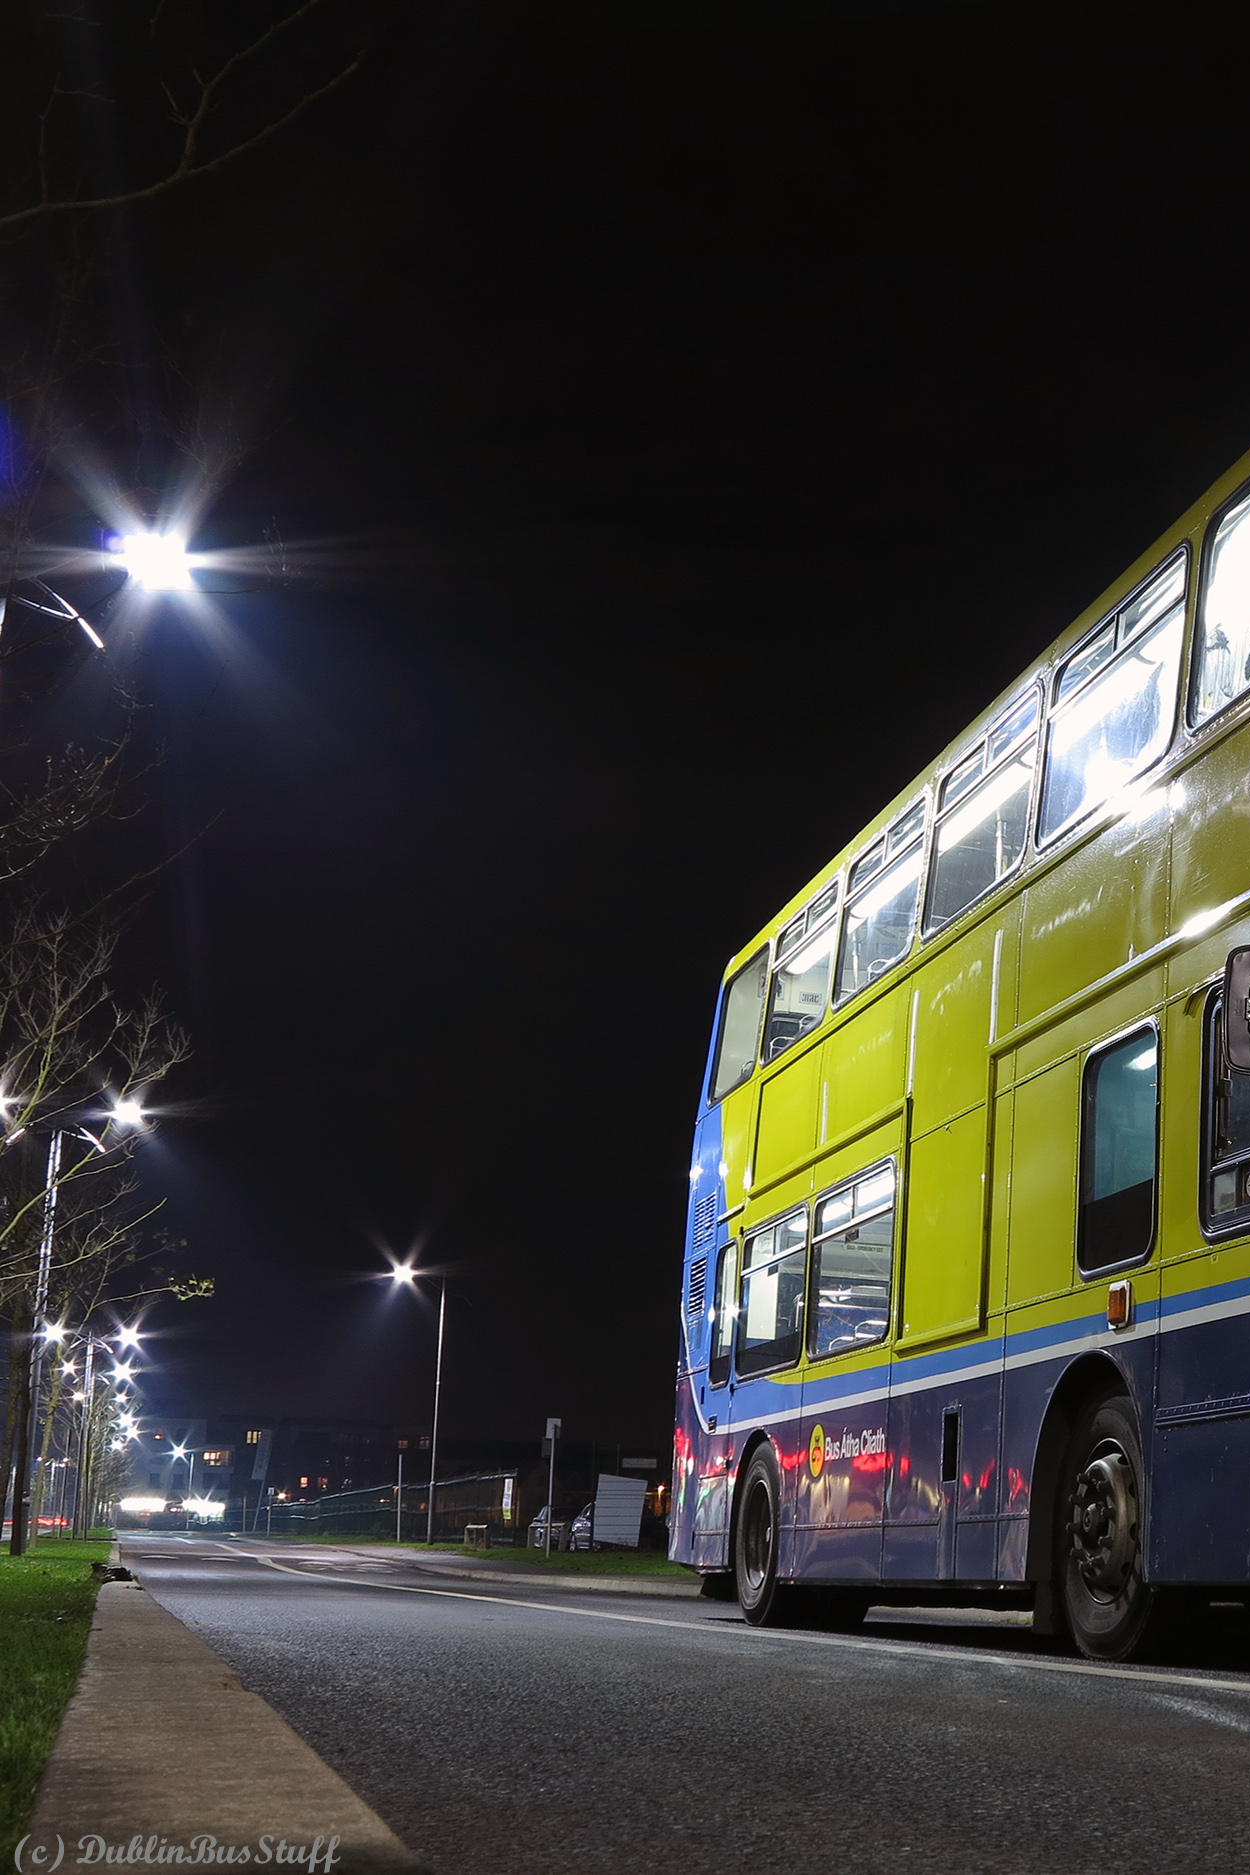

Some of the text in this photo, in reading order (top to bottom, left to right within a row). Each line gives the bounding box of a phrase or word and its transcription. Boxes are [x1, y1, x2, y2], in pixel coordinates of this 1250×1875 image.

[825, 1426, 886, 1462] Bus Átha Cliath
